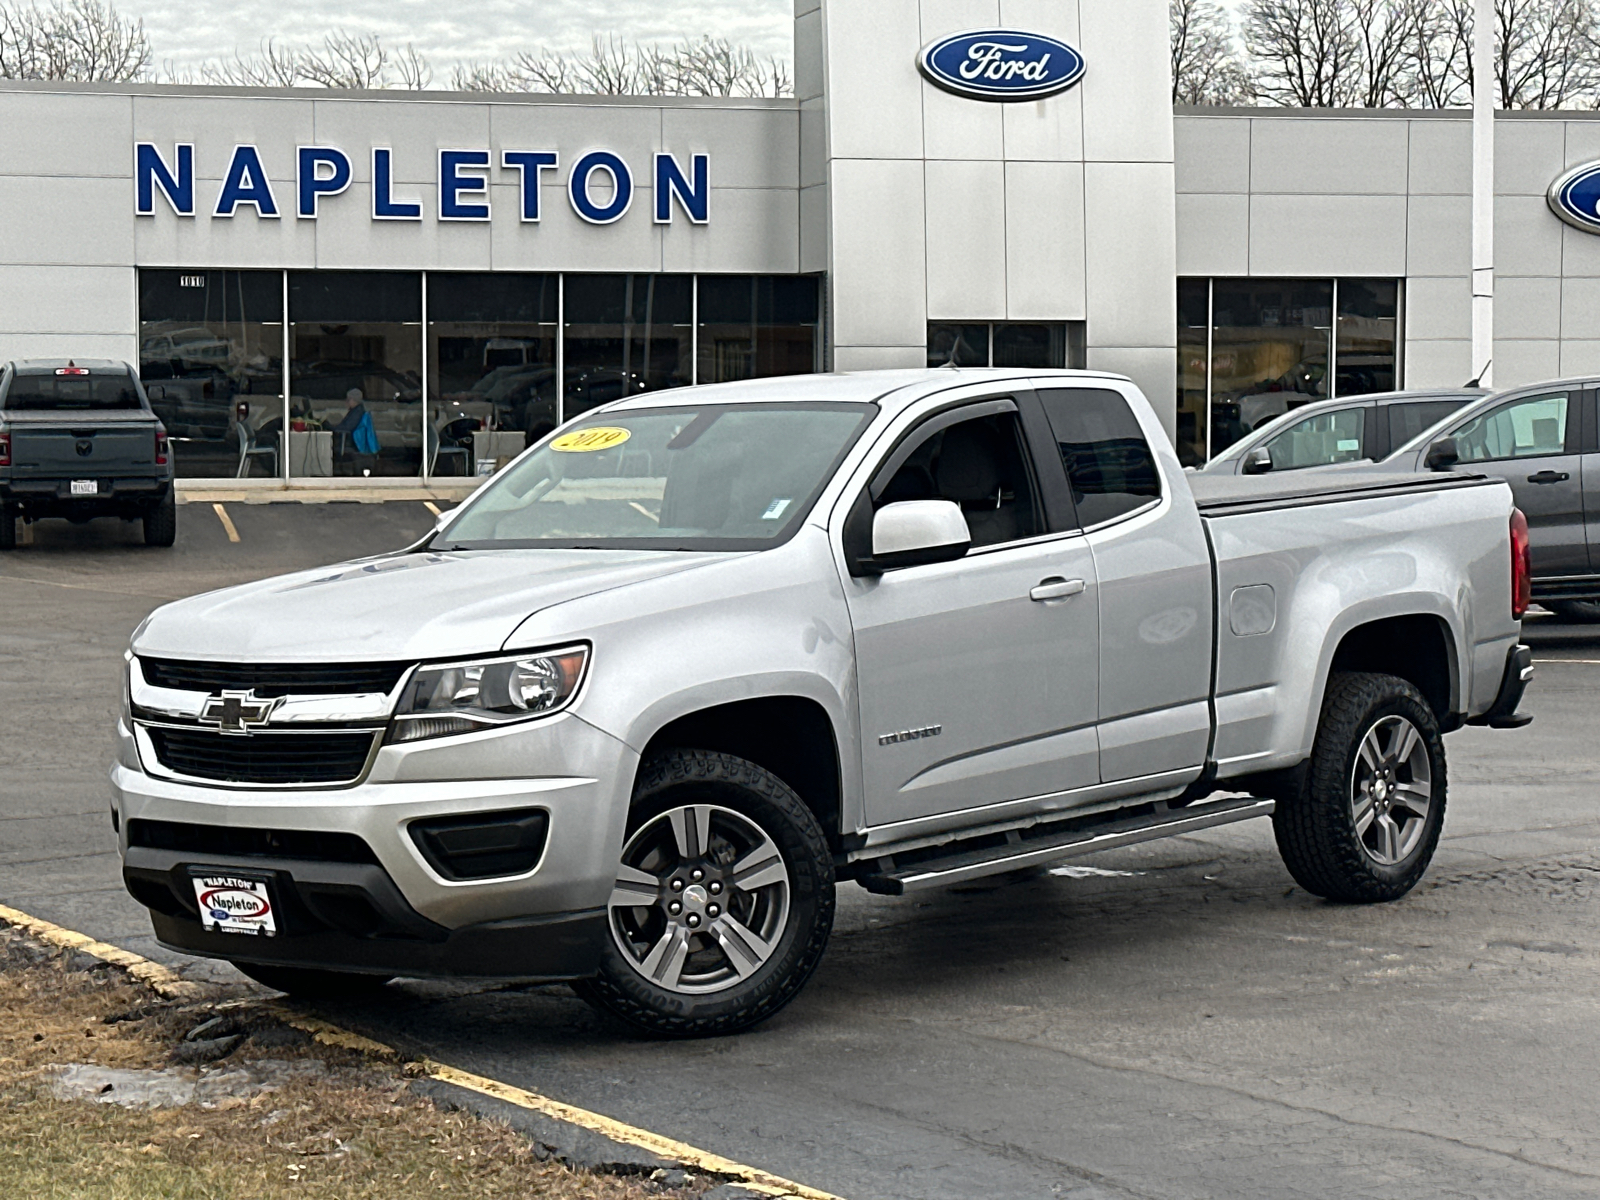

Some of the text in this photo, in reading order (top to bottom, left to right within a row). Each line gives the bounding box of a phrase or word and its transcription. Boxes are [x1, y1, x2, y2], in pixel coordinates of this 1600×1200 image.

[959, 42, 1051, 81] Ford
[134, 141, 711, 226] NAPLETON
[180, 275, 205, 288] 1010
[560, 431, 623, 447] 2019
[211, 894, 260, 911] Napleton
